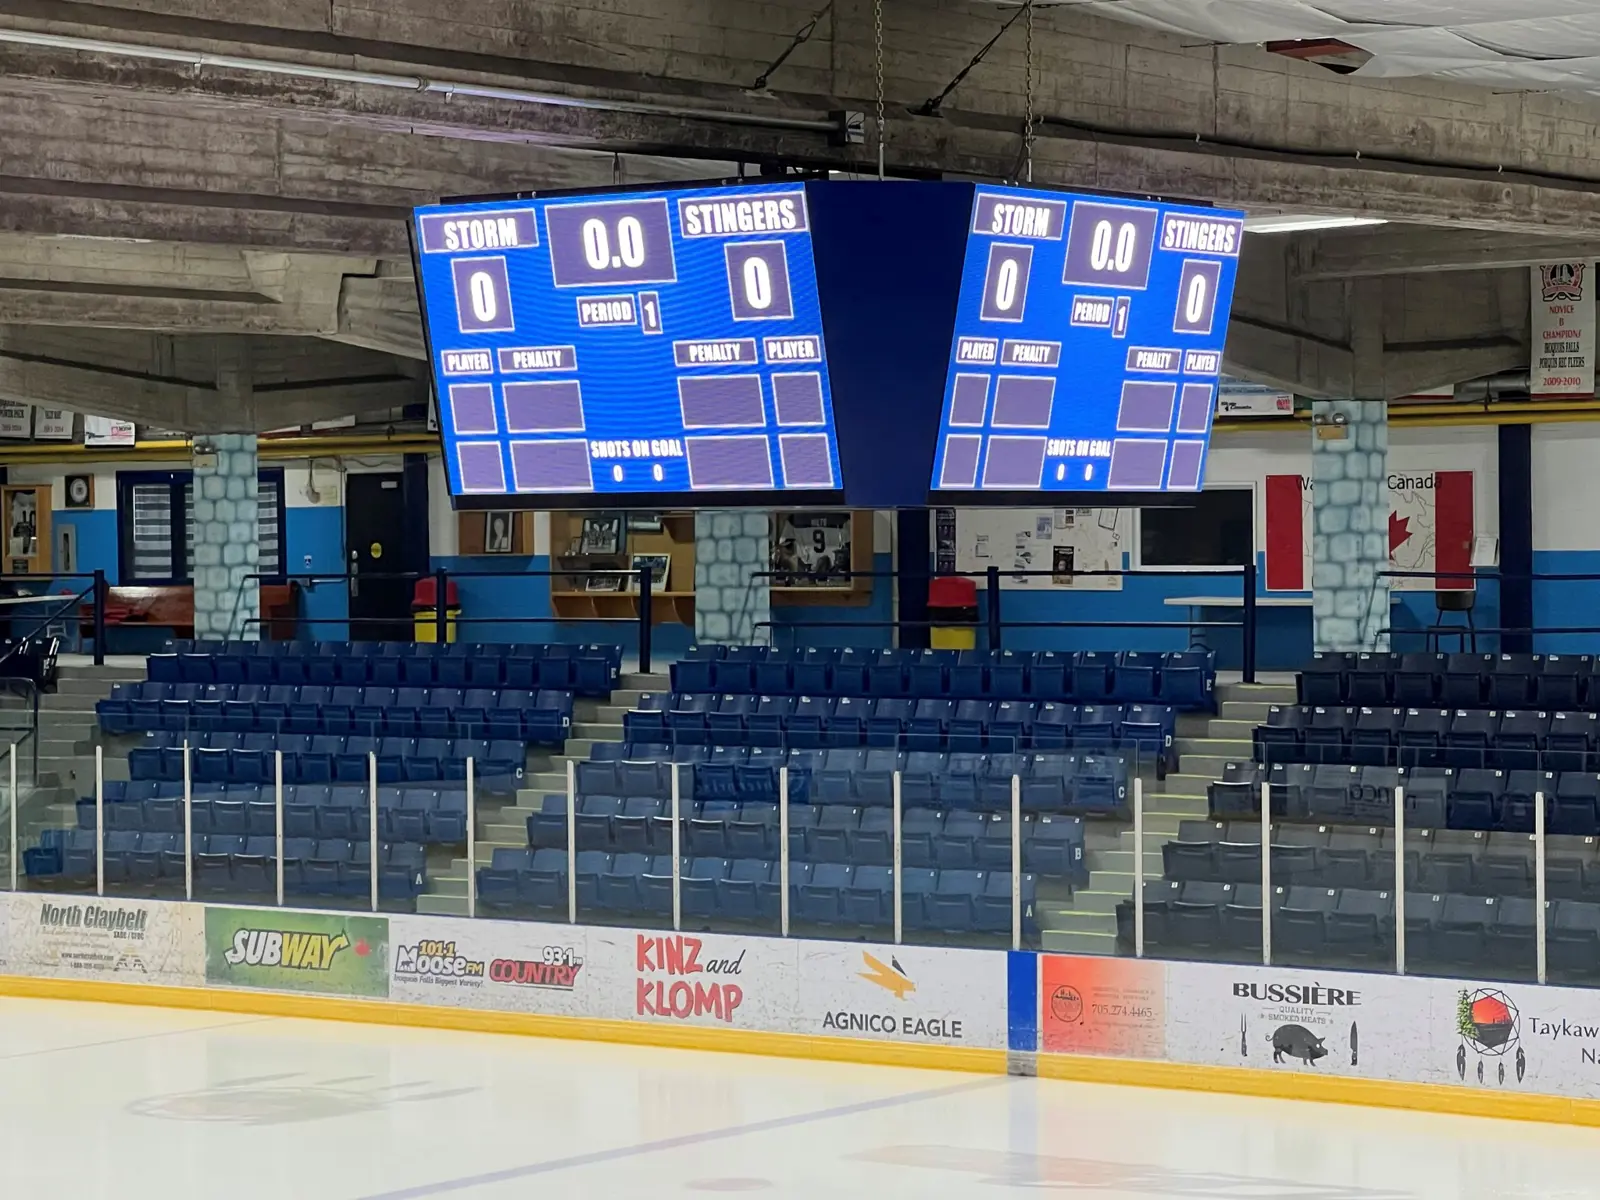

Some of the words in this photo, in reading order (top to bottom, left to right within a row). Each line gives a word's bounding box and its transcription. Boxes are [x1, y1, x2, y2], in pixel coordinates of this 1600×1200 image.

[685, 200, 797, 235] STINGERS
[992, 204, 1051, 237] STORM
[444, 218, 518, 249] STORM
[582, 216, 645, 270] 0.0
[1164, 219, 1236, 253] STINGERS
[1091, 220, 1136, 272] 0.0
[743, 256, 772, 309] 0
[995, 259, 1018, 311] 0
[469, 271, 497, 323] 0
[1186, 274, 1206, 323] 0
[581, 302, 632, 323] PERIOD
[644, 301, 657, 328] 1
[1074, 302, 1110, 324] PERIOD
[1117, 305, 1125, 332] 1
[1549, 305, 1574, 314] NOVICE
[1543, 329, 1582, 340] CHAMPIONS
[689, 343, 741, 362] PENALTY
[768, 340, 814, 359] PLAYER
[961, 341, 995, 360] PLAYER
[1012, 344, 1051, 363] PENALTY
[448, 353, 489, 371] PLAYER
[513, 350, 561, 369] PENALTY
[1136, 351, 1171, 369] PENALTY
[1186, 354, 1216, 371] PLAYER
[1543, 377, 1581, 387] 2009-2010
[591, 440, 630, 458] SHOTS
[632, 439, 650, 457] ON
[651, 438, 683, 457] GOAL
[1047, 439, 1075, 456] SHOTS
[1076, 440, 1088, 456] ON
[1089, 441, 1111, 457] GOAL
[613, 464, 623, 482] 0
[653, 464, 664, 482] 0
[1057, 463, 1064, 481] 0
[1084, 463, 1093, 481] 0
[1388, 473, 1443, 490] Canada
[813, 529, 826, 553] 9
[1206, 679, 1212, 691] E
[563, 717, 570, 727] D
[1165, 735, 1172, 747] D
[516, 768, 523, 779] C
[1118, 786, 1125, 799] C
[1075, 848, 1082, 860] B
[415, 873, 423, 885] A
[40, 903, 83, 927] North
[84, 906, 148, 932] Claybelt
[1025, 904, 1033, 917] A
[227, 928, 349, 971] SUBWAY
[636, 934, 704, 976] KINZ
[706, 949, 746, 976] and
[395, 945, 467, 978] Moose
[466, 961, 485, 977] FM
[490, 959, 583, 987] COUNTRY
[636, 978, 744, 1022] KLOMP
[1233, 981, 1362, 1006] BUSSIÈRE
[1092, 1003, 1153, 1018] 705.274.4465
[1268, 1013, 1302, 1022] SMOKED
[1301, 1015, 1327, 1024] MEATS
[1279, 1005, 1315, 1015] QUALITY
[822, 1011, 896, 1034] AGNICO
[902, 1017, 962, 1039] EAGLE
[1528, 1017, 1600, 1041] Taykaw
